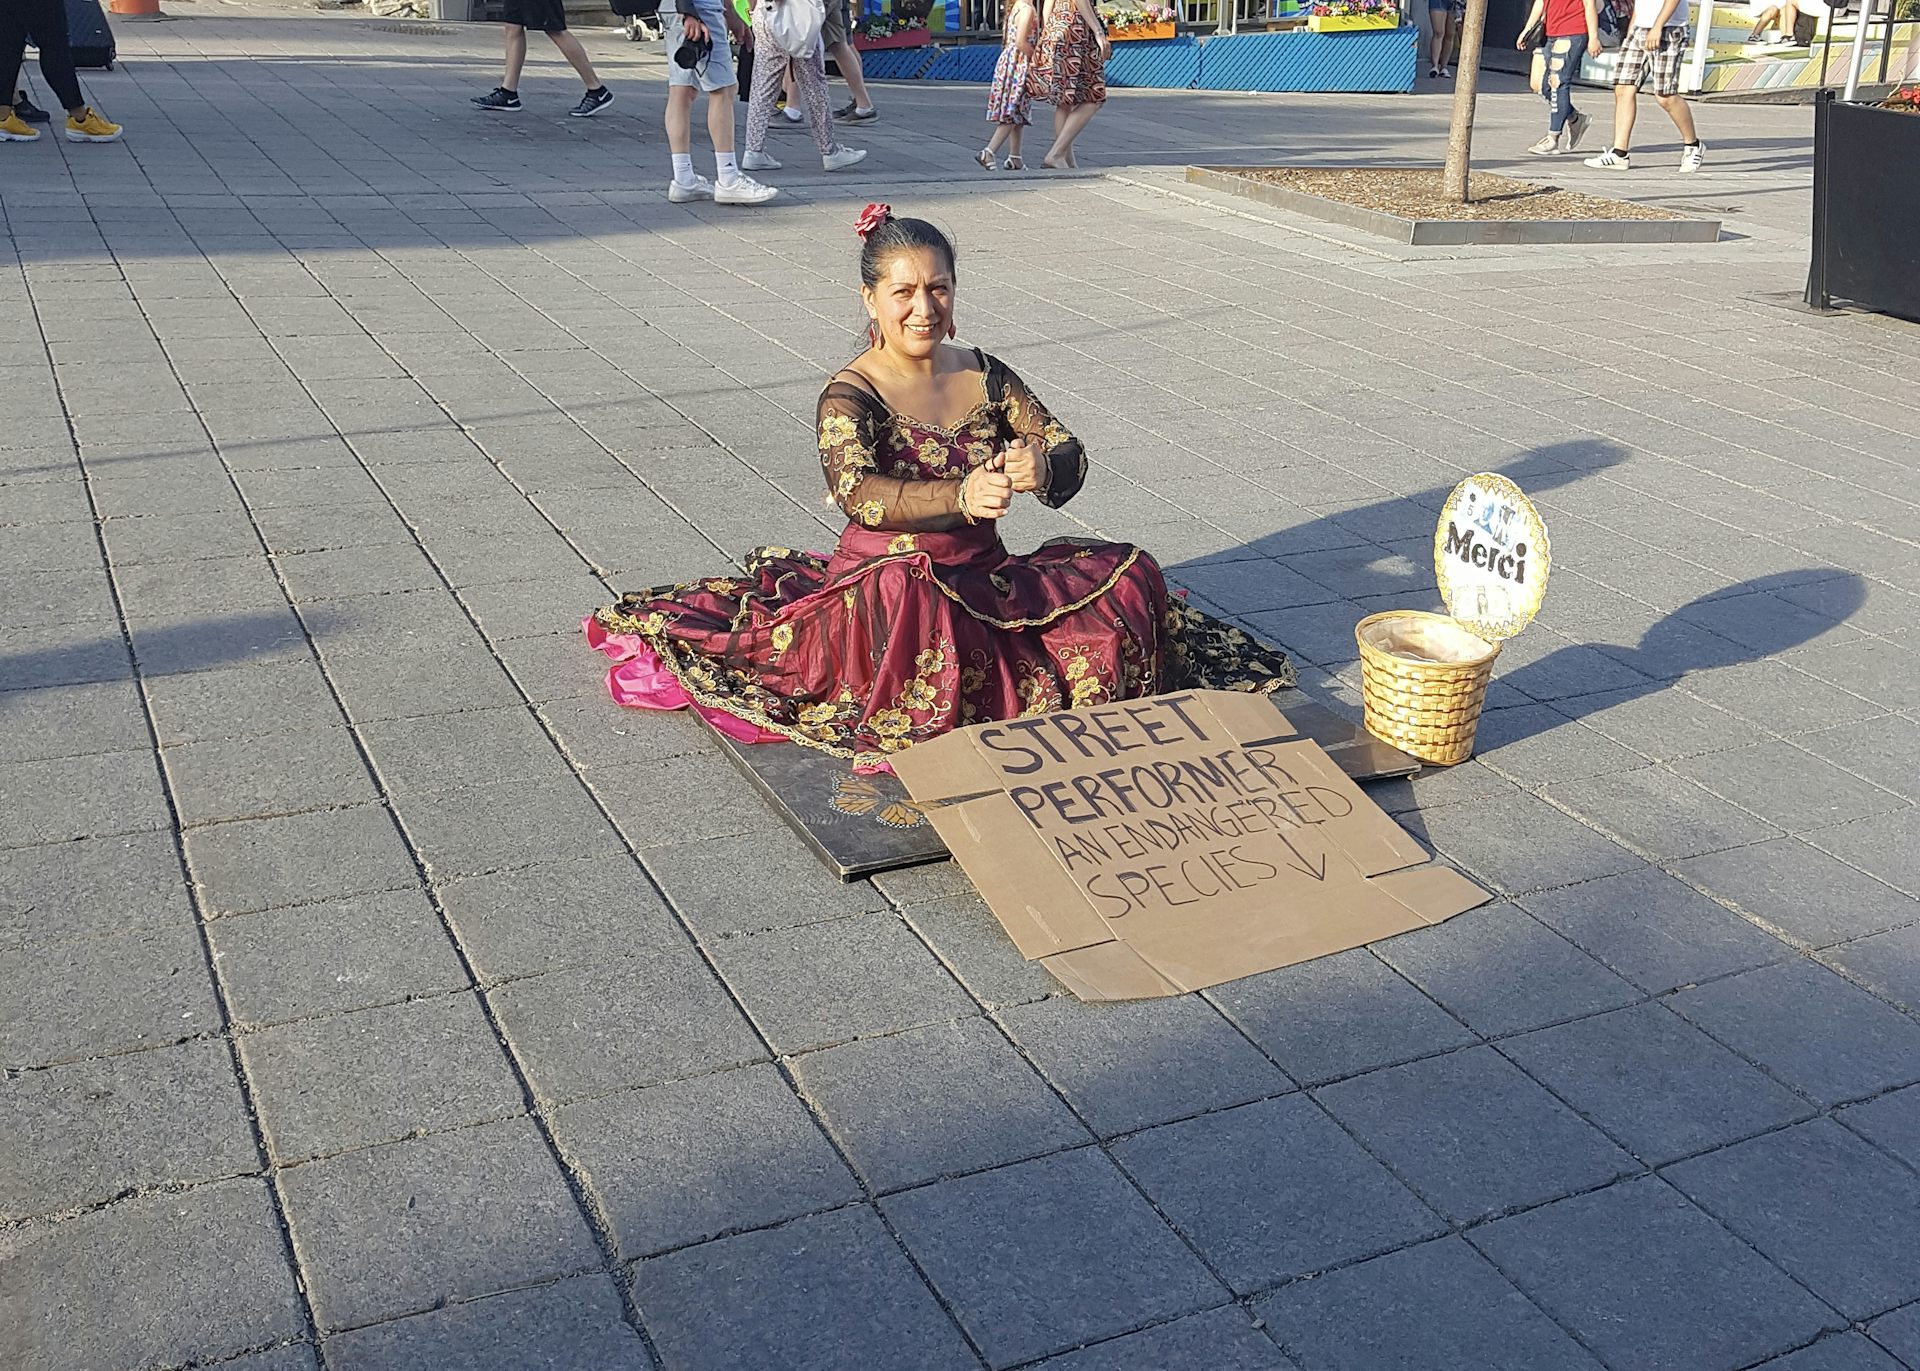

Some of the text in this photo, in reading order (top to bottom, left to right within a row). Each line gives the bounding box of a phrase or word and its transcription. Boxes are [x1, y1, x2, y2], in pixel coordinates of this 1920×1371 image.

[1444, 521, 1527, 584] Merci
[979, 694, 1211, 775] STREET
[1010, 749, 1299, 829] PERFORMER
[1054, 786, 1353, 871] AN ENDANGERED
[1086, 845, 1277, 919] SPECIES
